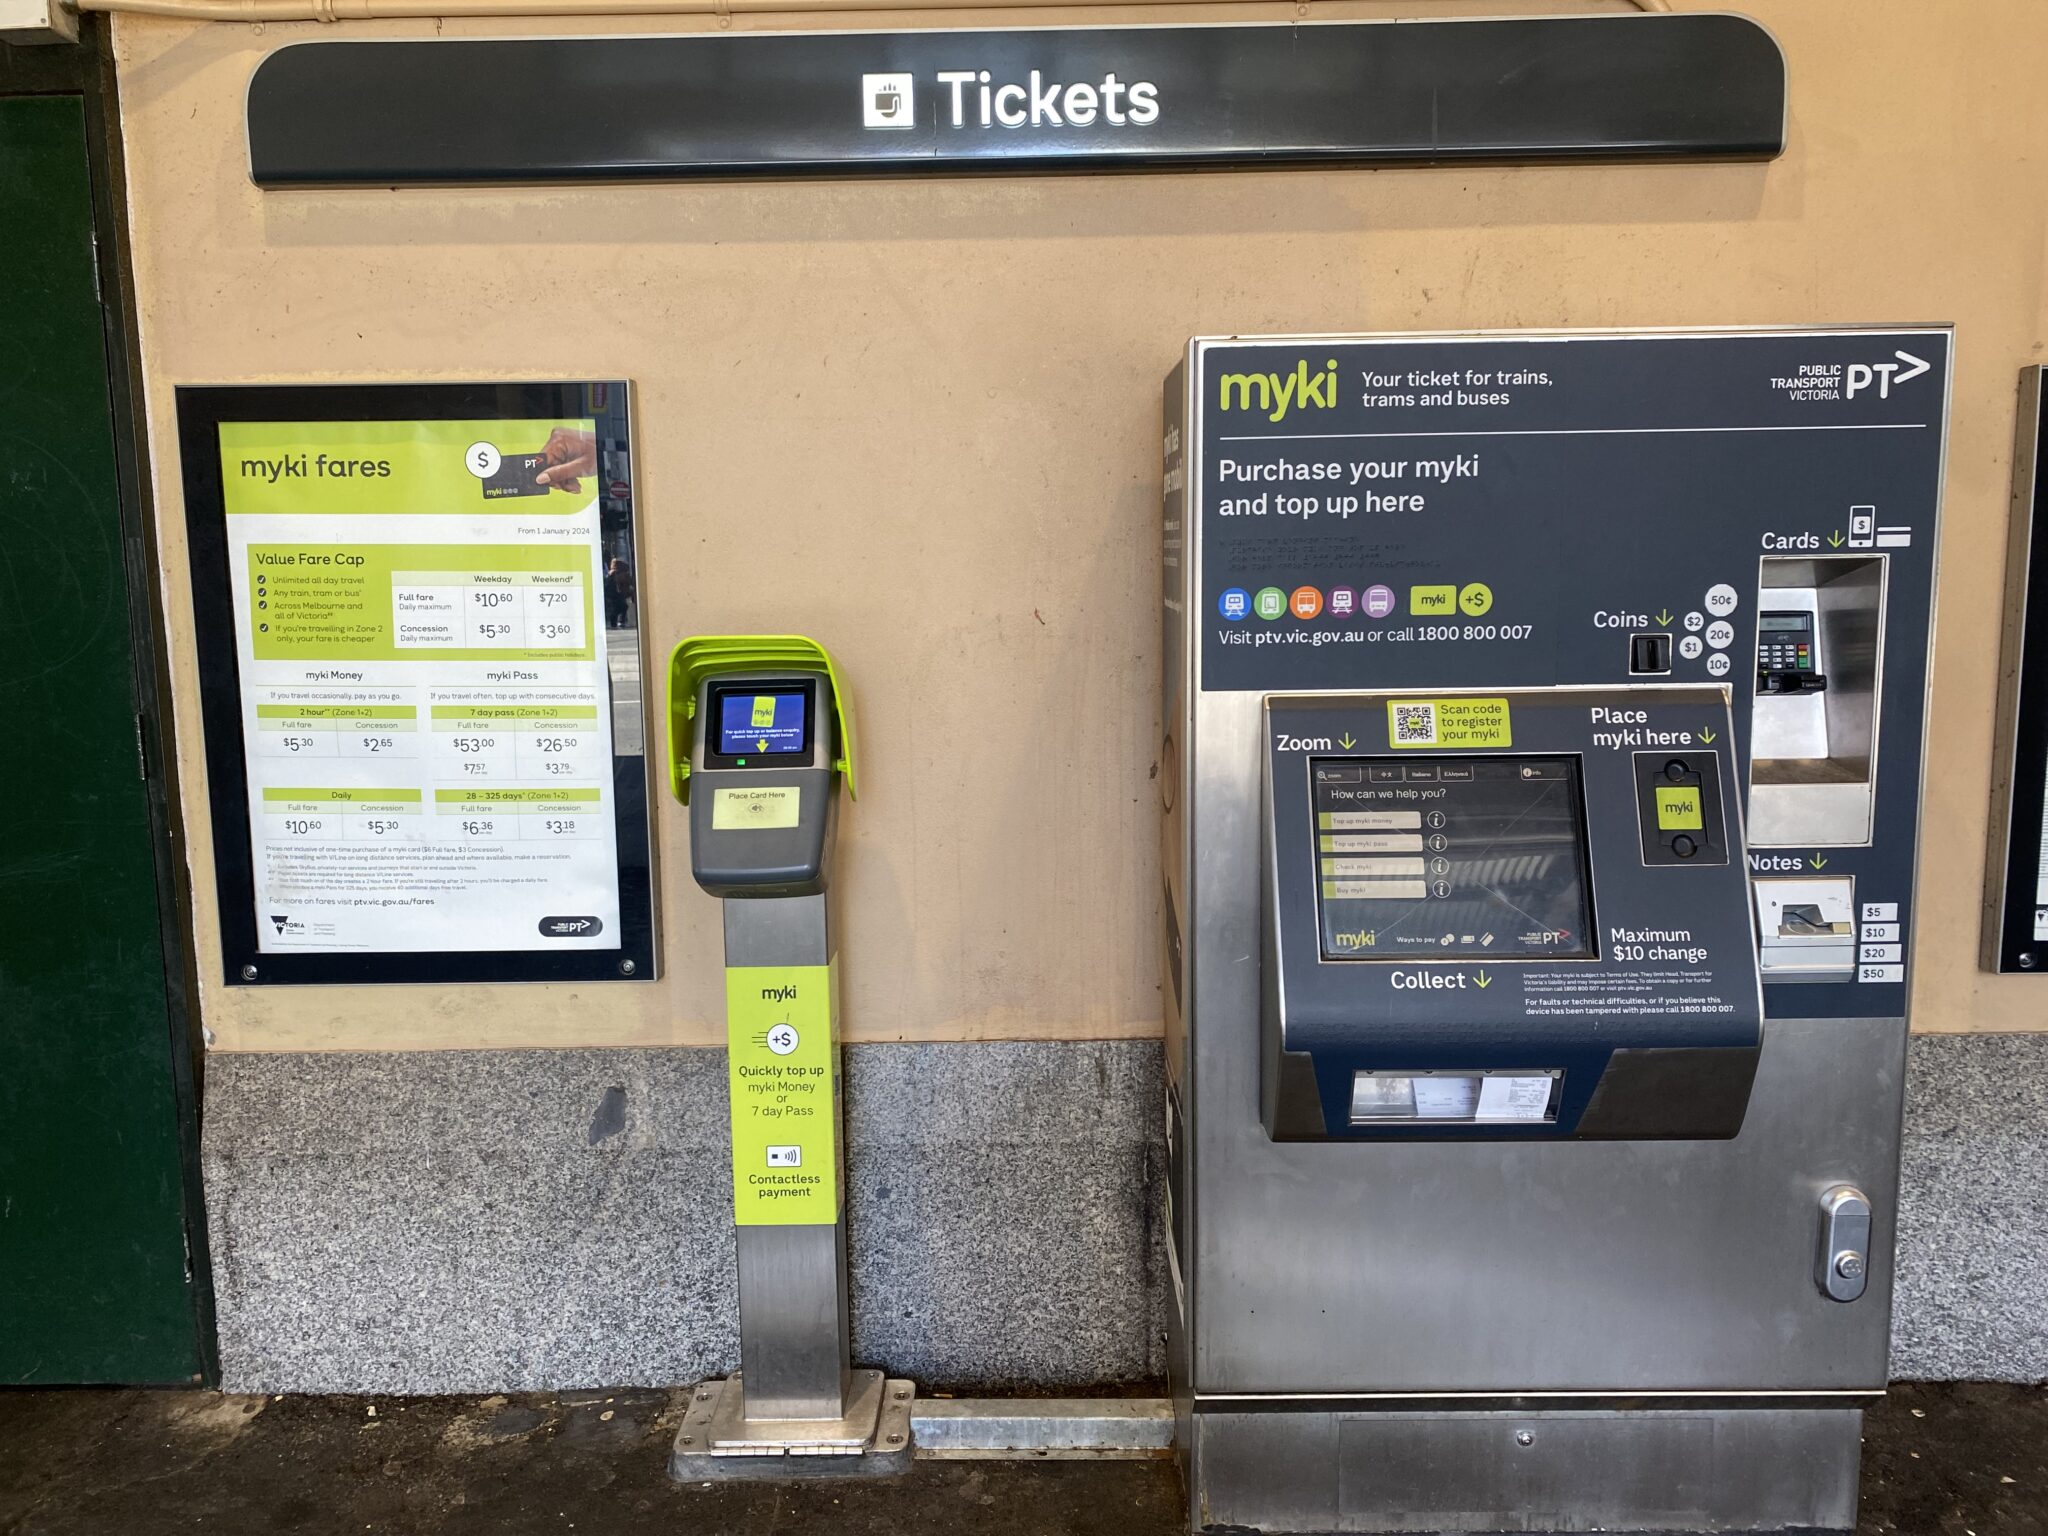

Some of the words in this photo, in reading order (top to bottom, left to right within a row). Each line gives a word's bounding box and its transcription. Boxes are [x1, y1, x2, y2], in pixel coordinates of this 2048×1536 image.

[937, 70, 1159, 129] Tickets
[1799, 365, 1841, 376] PUBLIC
[1362, 372, 1402, 387] Your
[1407, 371, 1460, 386] ticket
[1465, 370, 1491, 385] for
[1497, 369, 1552, 386] trains,
[1770, 377, 1841, 388] TRANSPORT
[1220, 359, 1337, 422] myki
[1789, 389, 1840, 400] VICTORIA
[1362, 393, 1415, 407] trams
[1420, 390, 1452, 406] and
[1457, 390, 1510, 405] buses
[241, 454, 307, 483] myki
[315, 454, 391, 477] fares
[1220, 458, 1342, 482] Purchase
[1350, 461, 1408, 485] your
[1416, 454, 1479, 483] myki
[1219, 493, 1267, 516] and
[1275, 494, 1319, 520] top
[1327, 496, 1358, 519] up
[1366, 490, 1424, 512] here
[542, 528, 570, 536] January
[1762, 532, 1819, 549] Cards
[256, 553, 295, 565] Value
[299, 553, 331, 565] Fare
[335, 553, 364, 568] Cap
[323, 577, 338, 586] day
[474, 576, 512, 584] Weekday
[399, 593, 414, 601] Full
[475, 593, 513, 607] $10.60
[1421, 594, 1446, 607] myki
[1594, 610, 1648, 628] Coins
[1686, 615, 1701, 628] $2
[479, 624, 510, 638] $5.30
[539, 624, 570, 639] $3.60
[1219, 630, 1252, 644] Visit
[1255, 629, 1364, 647] ptv.vic.gov.au
[1367, 631, 1383, 642] or
[1387, 627, 1414, 641] call
[1418, 626, 1459, 641] 1800
[1463, 626, 1496, 640] 800
[1500, 625, 1532, 639] 007
[1685, 642, 1697, 653] $1
[306, 671, 329, 681] myki
[331, 671, 363, 681] Money
[487, 671, 511, 682] myki
[513, 671, 538, 679] Pass
[332, 708, 355, 717] (Zone
[477, 709, 493, 718] day
[517, 708, 540, 717] (Zone
[754, 709, 772, 717] myki
[1441, 704, 1470, 714] Scan
[1473, 704, 1501, 714] code
[1591, 707, 1647, 724] Place
[1441, 718, 1454, 727] to
[1457, 716, 1502, 729] register
[1442, 729, 1468, 742] your
[1472, 728, 1500, 740] myki
[1593, 728, 1641, 750] myki
[1646, 729, 1691, 745] here
[284, 738, 313, 751] $5.30
[363, 738, 392, 752] $2.65
[453, 738, 494, 752] $53.00
[536, 738, 577, 752] $26.50
[1277, 735, 1331, 751] Zoom
[332, 791, 352, 800] Daily
[1331, 790, 1354, 799] How
[1357, 791, 1375, 799] can
[1396, 789, 1418, 800] help
[1421, 788, 1446, 800] you?
[1665, 801, 1693, 815] myki
[285, 820, 321, 834] $10.60
[368, 821, 398, 835] $5.30
[1747, 854, 1802, 871] Notes
[269, 896, 282, 905] For
[354, 898, 435, 907] ptv.vic.gov.au/fares
[1867, 907, 1880, 917] $5
[1336, 930, 1375, 949] myki
[1611, 927, 1690, 942] Maximum
[1866, 928, 1885, 938] $10
[1613, 945, 1644, 962] $10
[1648, 946, 1707, 963] change
[1865, 948, 1885, 958] $20
[1391, 971, 1466, 989] Collect
[1863, 969, 1884, 979] $50
[762, 985, 796, 1003] myki
[1585, 1007, 1621, 1015] tampered
[1640, 1007, 1664, 1015] please
[739, 1065, 783, 1078] Quickly
[786, 1066, 806, 1077] top
[809, 1067, 824, 1077] up
[748, 1082, 775, 1095] myki
[778, 1081, 815, 1094] Money
[776, 1095, 788, 1103] or
[752, 1106, 759, 1116] 7
[762, 1106, 783, 1119] day
[786, 1105, 814, 1116] Pass
[749, 1174, 820, 1184] Contactless
[759, 1187, 810, 1199] payment
